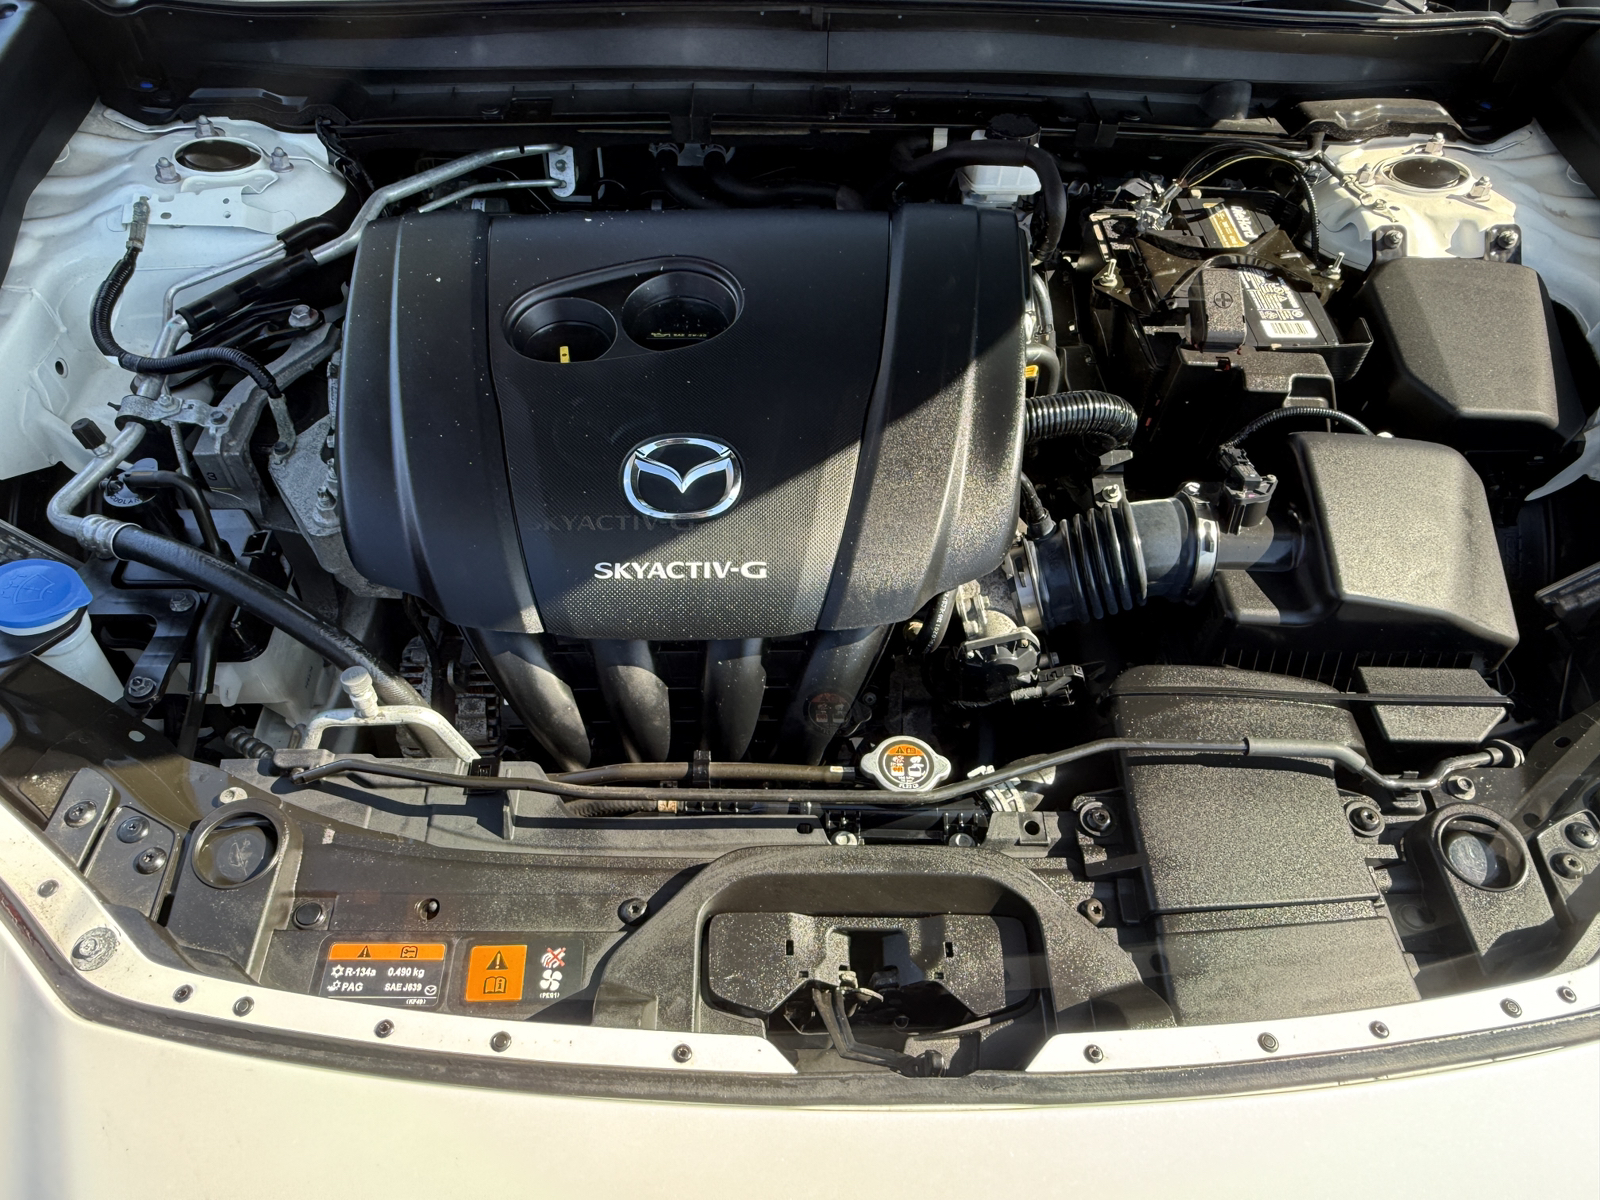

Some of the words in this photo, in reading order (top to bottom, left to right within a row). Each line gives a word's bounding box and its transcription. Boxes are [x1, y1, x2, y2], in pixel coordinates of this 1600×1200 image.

[594, 561, 768, 579] SKYACTIV-G
[344, 967, 377, 977] R-134a
[387, 967, 412, 977] 0.490
[412, 967, 425, 979] kg
[341, 982, 364, 992] PAG
[384, 982, 402, 992] SAE
[403, 982, 423, 992] J639
